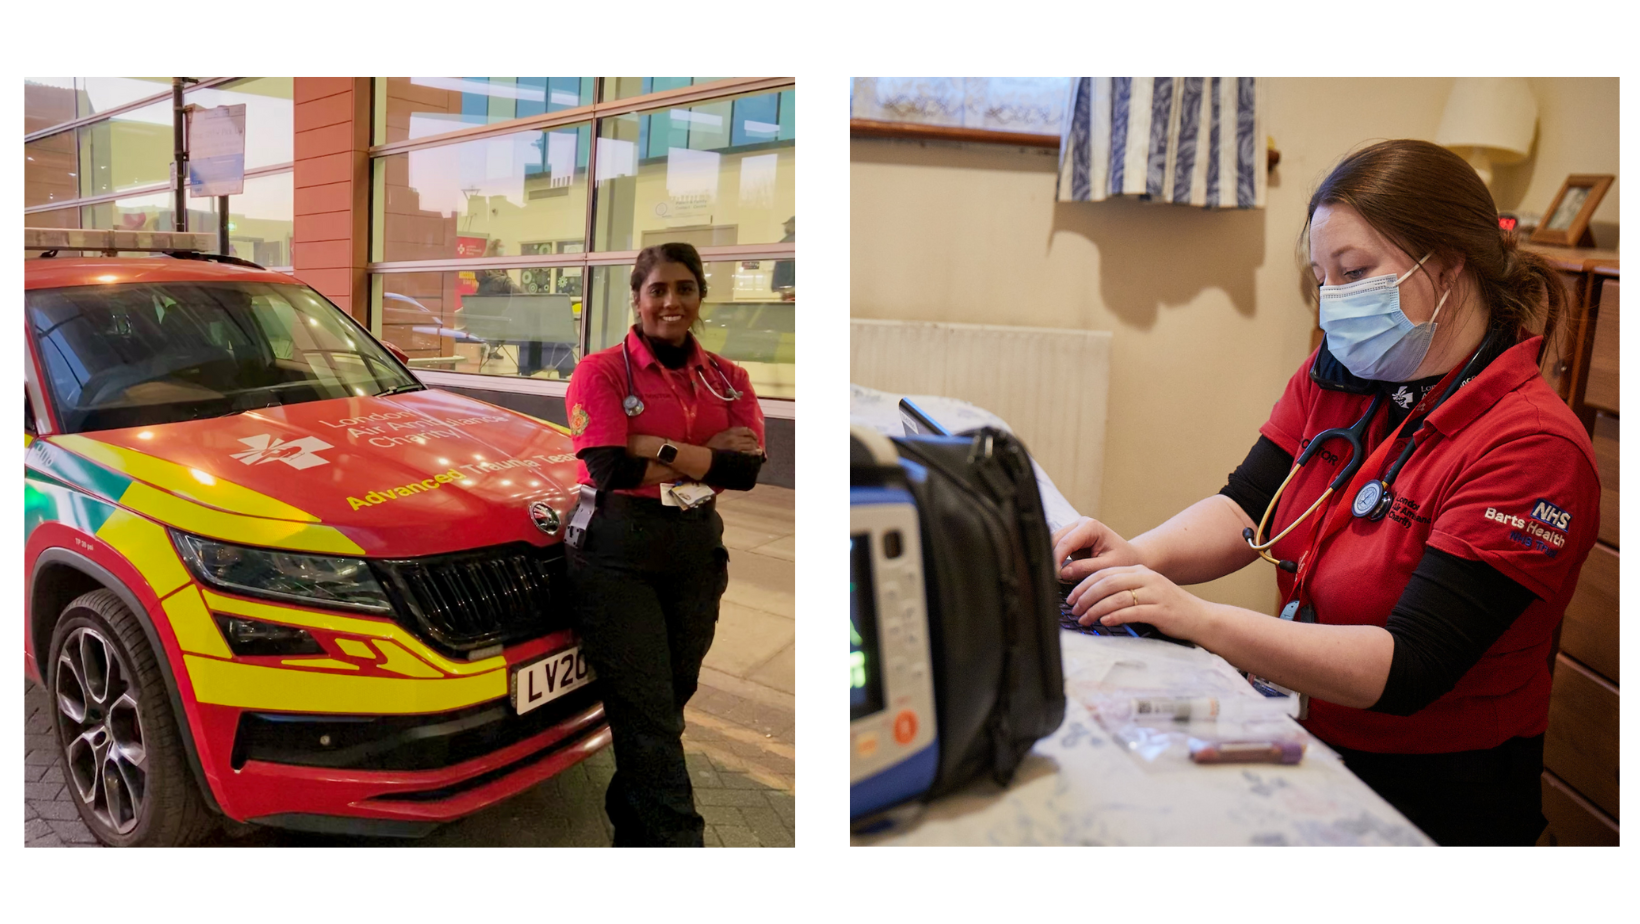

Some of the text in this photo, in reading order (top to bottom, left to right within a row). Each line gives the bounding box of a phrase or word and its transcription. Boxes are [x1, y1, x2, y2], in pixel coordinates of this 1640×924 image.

[347, 425, 386, 438] Air
[368, 430, 461, 448] Charity
[346, 468, 466, 511] Advanced
[1484, 507, 1565, 548] Barts Health
[1532, 502, 1571, 530] NHS
[1509, 531, 1533, 547] NHS
